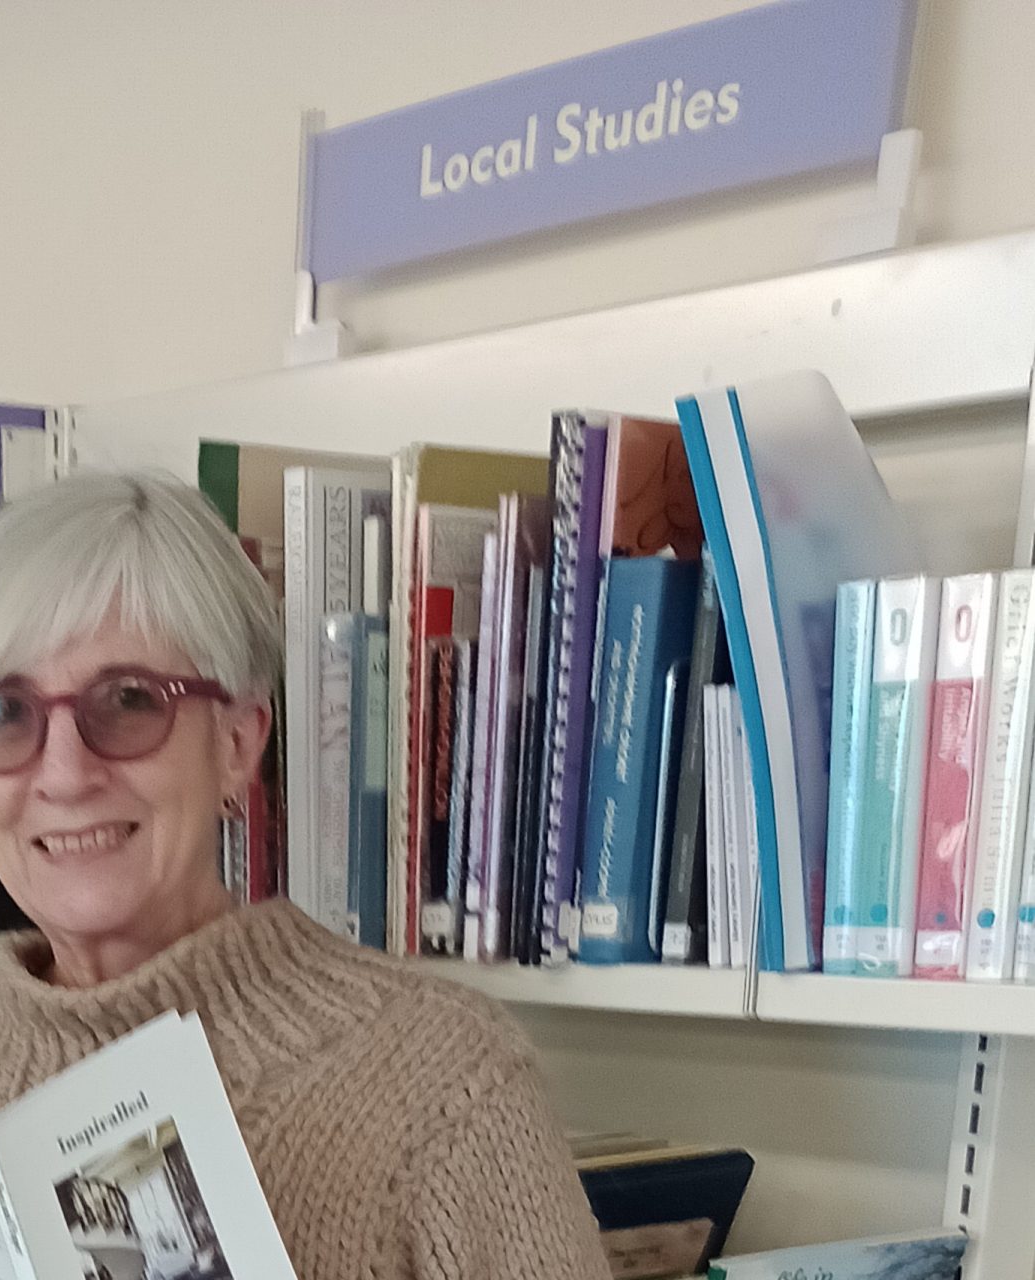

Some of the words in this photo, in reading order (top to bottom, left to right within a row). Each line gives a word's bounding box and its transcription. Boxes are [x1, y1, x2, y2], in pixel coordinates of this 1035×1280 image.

[419, 117, 538, 199] Local
[553, 78, 742, 165] Studies
[328, 485, 346, 592] YEARS
[937, 687, 954, 763] Irritability
[996, 676, 1017, 763] Works
